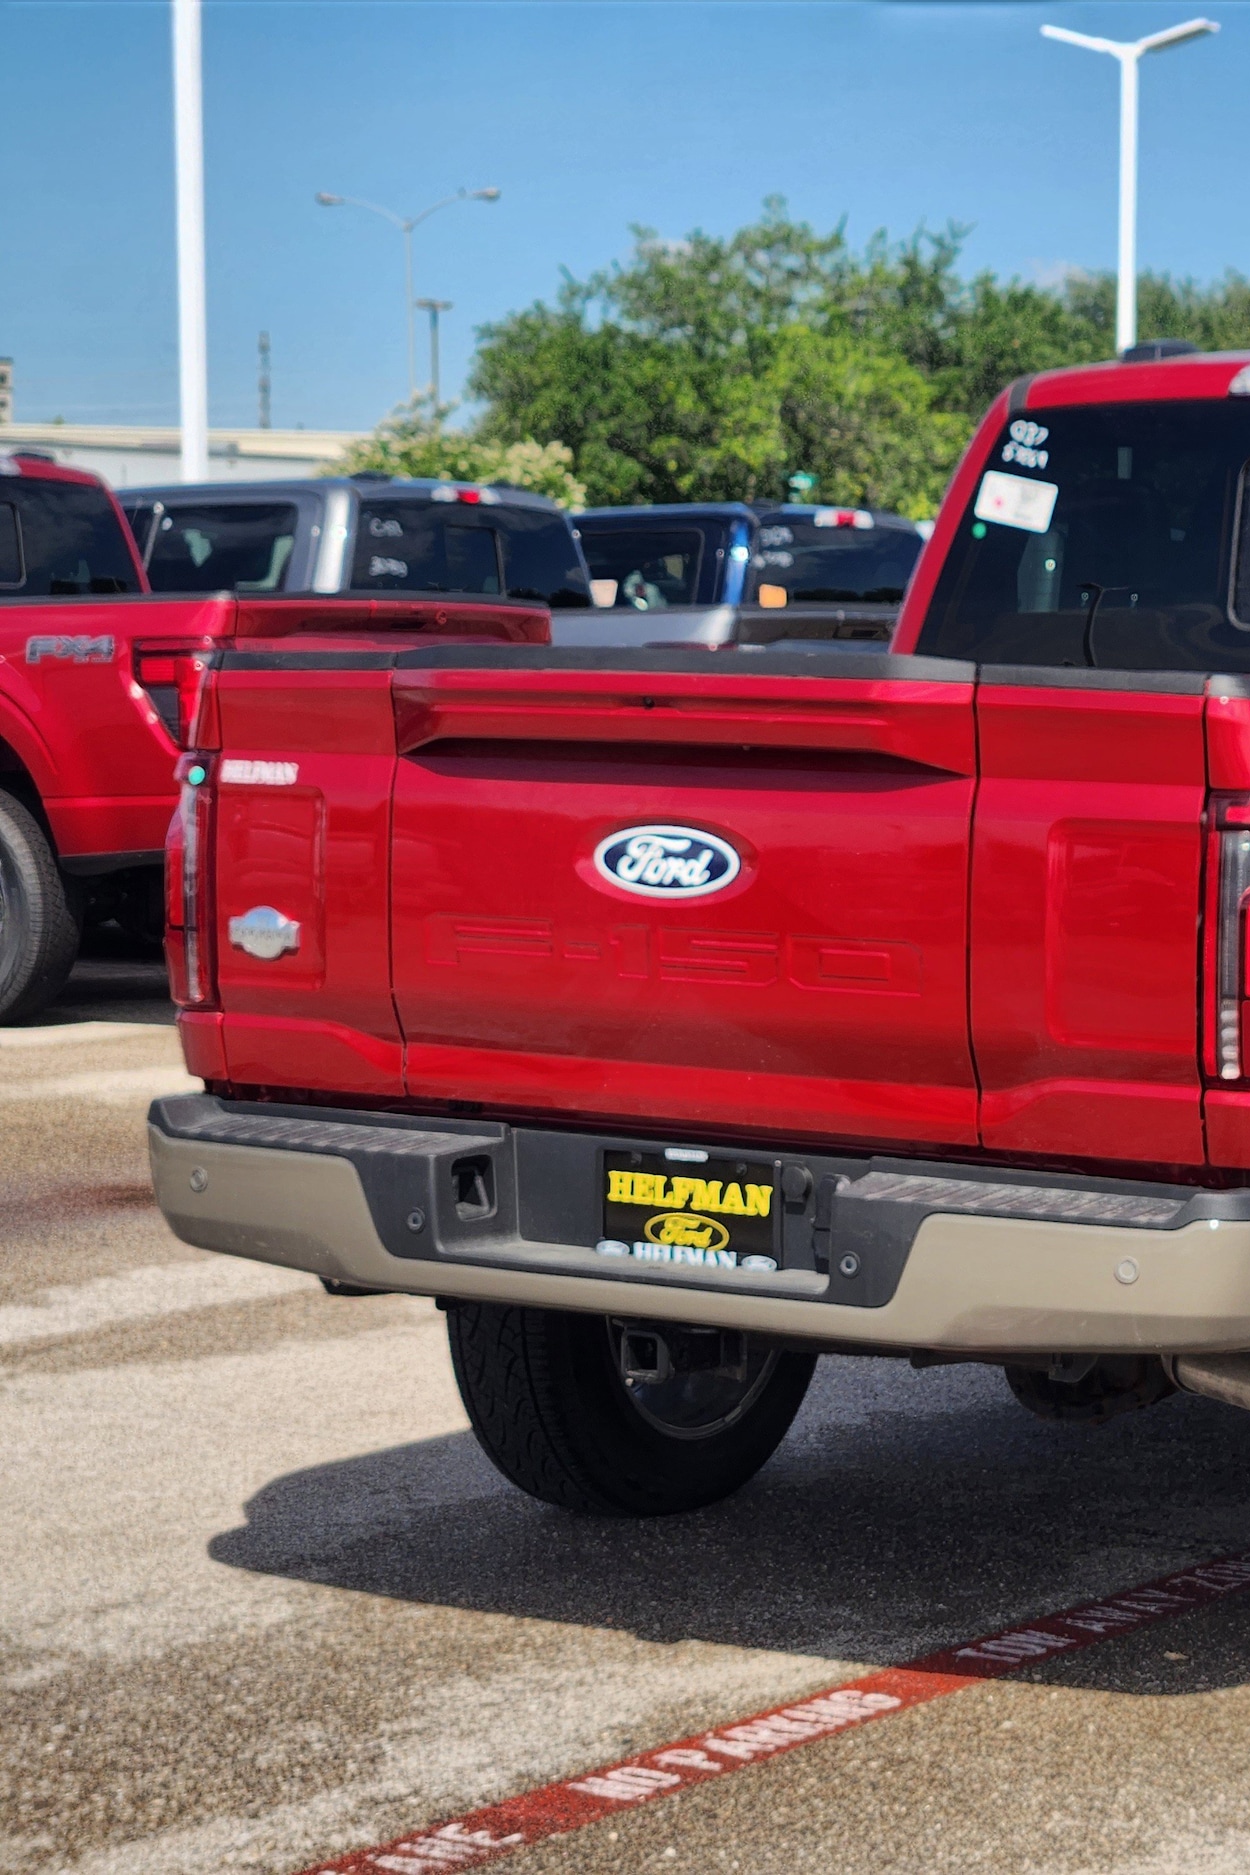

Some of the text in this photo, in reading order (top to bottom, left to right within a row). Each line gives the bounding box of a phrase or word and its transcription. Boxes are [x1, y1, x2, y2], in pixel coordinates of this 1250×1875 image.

[26, 634, 115, 664] FX4
[616, 833, 712, 888] Ford
[424, 912, 924, 997] F-150
[607, 1170, 774, 1217] HELFMAN
[658, 1215, 714, 1248] Ford
[567, 1766, 682, 1801] NO
[653, 1688, 902, 1771] PARKING
[951, 1629, 1077, 1664] TOW
